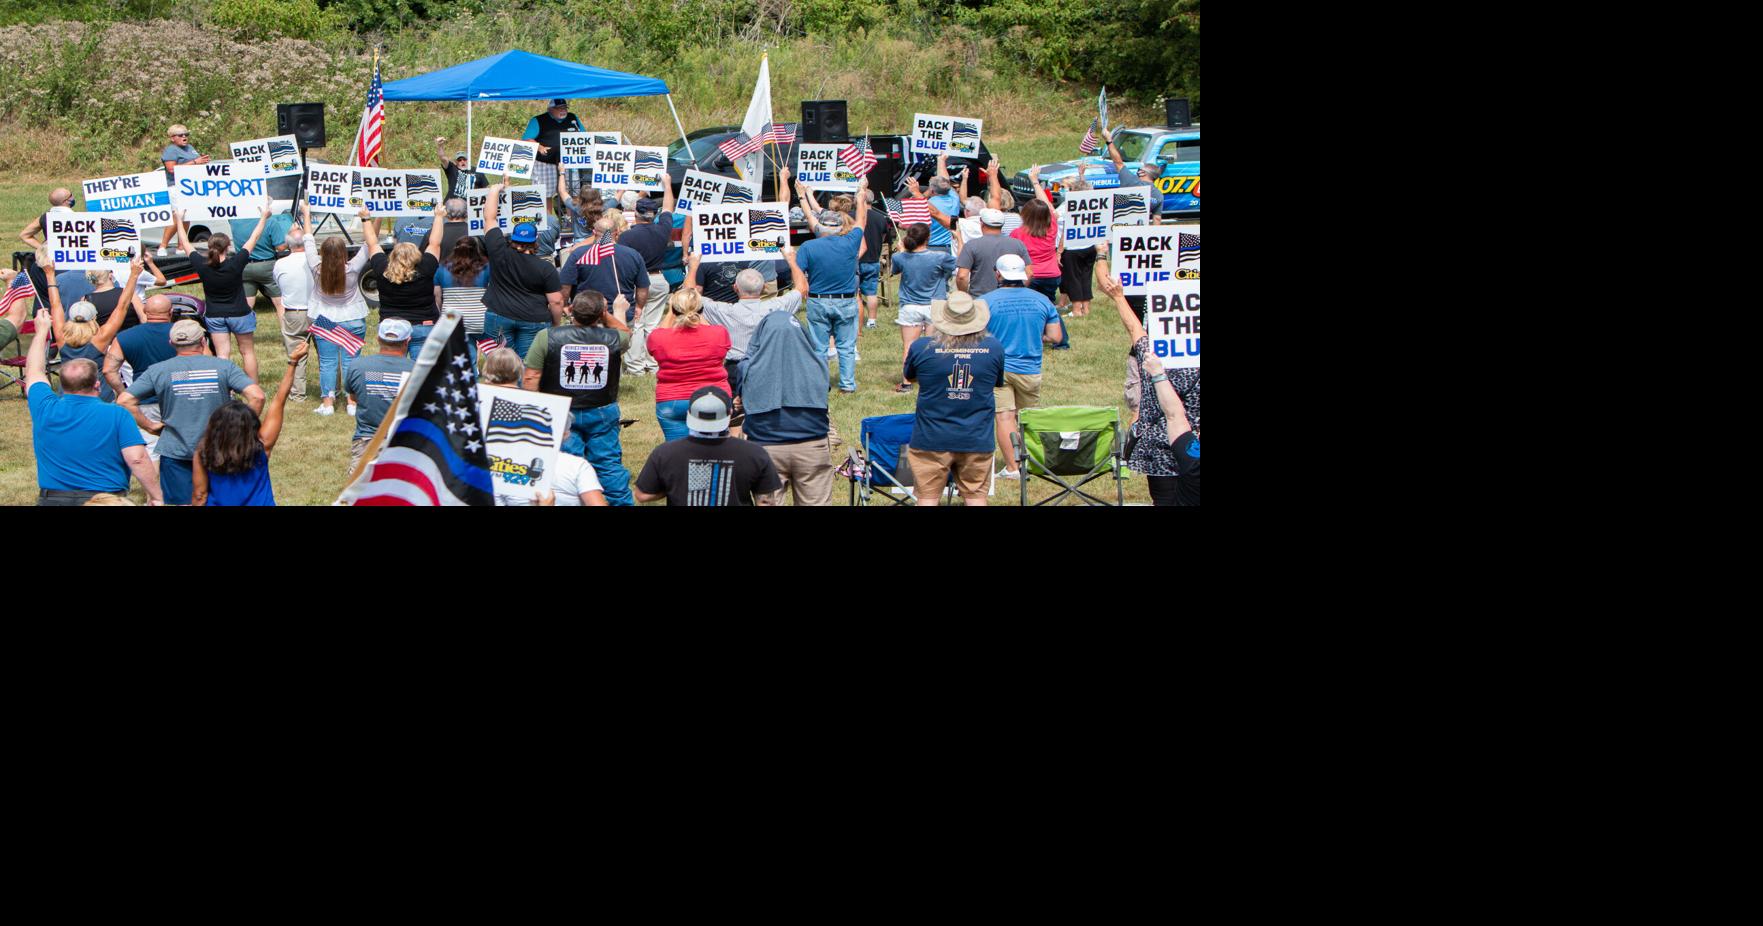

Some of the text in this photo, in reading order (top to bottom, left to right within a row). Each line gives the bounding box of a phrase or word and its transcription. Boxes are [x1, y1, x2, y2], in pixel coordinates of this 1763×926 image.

[918, 119, 950, 131] BACK
[561, 137, 591, 145] BACK
[920, 130, 943, 140] THE
[483, 141, 511, 152] BACK
[916, 139, 947, 150] BLUE
[233, 145, 266, 157] BACK
[485, 151, 504, 161] THE
[565, 147, 586, 155] THE
[596, 151, 631, 161] BACK
[800, 150, 833, 160] BACK
[478, 160, 505, 171] BLUE
[562, 156, 591, 164] BLUE
[803, 161, 828, 171] THE
[206, 165, 230, 176] WE
[599, 162, 624, 172] THE
[310, 170, 348, 183] BACK
[363, 177, 402, 187] BACK
[594, 173, 629, 184] BLUE
[799, 172, 831, 182] BLUE
[84, 176, 141, 194] THEY'RE
[180, 178, 264, 197] SUPPORT
[313, 183, 341, 195] THE
[684, 176, 722, 193] BACK
[368, 189, 396, 199] THE
[470, 194, 507, 206] BAK
[686, 188, 712, 203] THE
[100, 194, 156, 211] HUMAN
[308, 195, 346, 208] BLUE
[365, 201, 403, 211] BLUE
[1067, 197, 1109, 212] BACK
[140, 210, 170, 223] TOO
[208, 205, 237, 217] YOU
[470, 218, 507, 230] BLE
[699, 212, 744, 226] BACK
[1071, 212, 1101, 225] THE
[52, 220, 96, 233] BACK
[1066, 225, 1107, 240] BLUE
[704, 227, 737, 240] THE
[57, 235, 89, 248] THE
[748, 238, 777, 248] Cities
[1120, 236, 1172, 251] BACK
[701, 241, 745, 255] BLUE
[54, 250, 97, 263] BLUE
[1125, 254, 1163, 269] THE
[1120, 271, 1171, 287] BLUE
